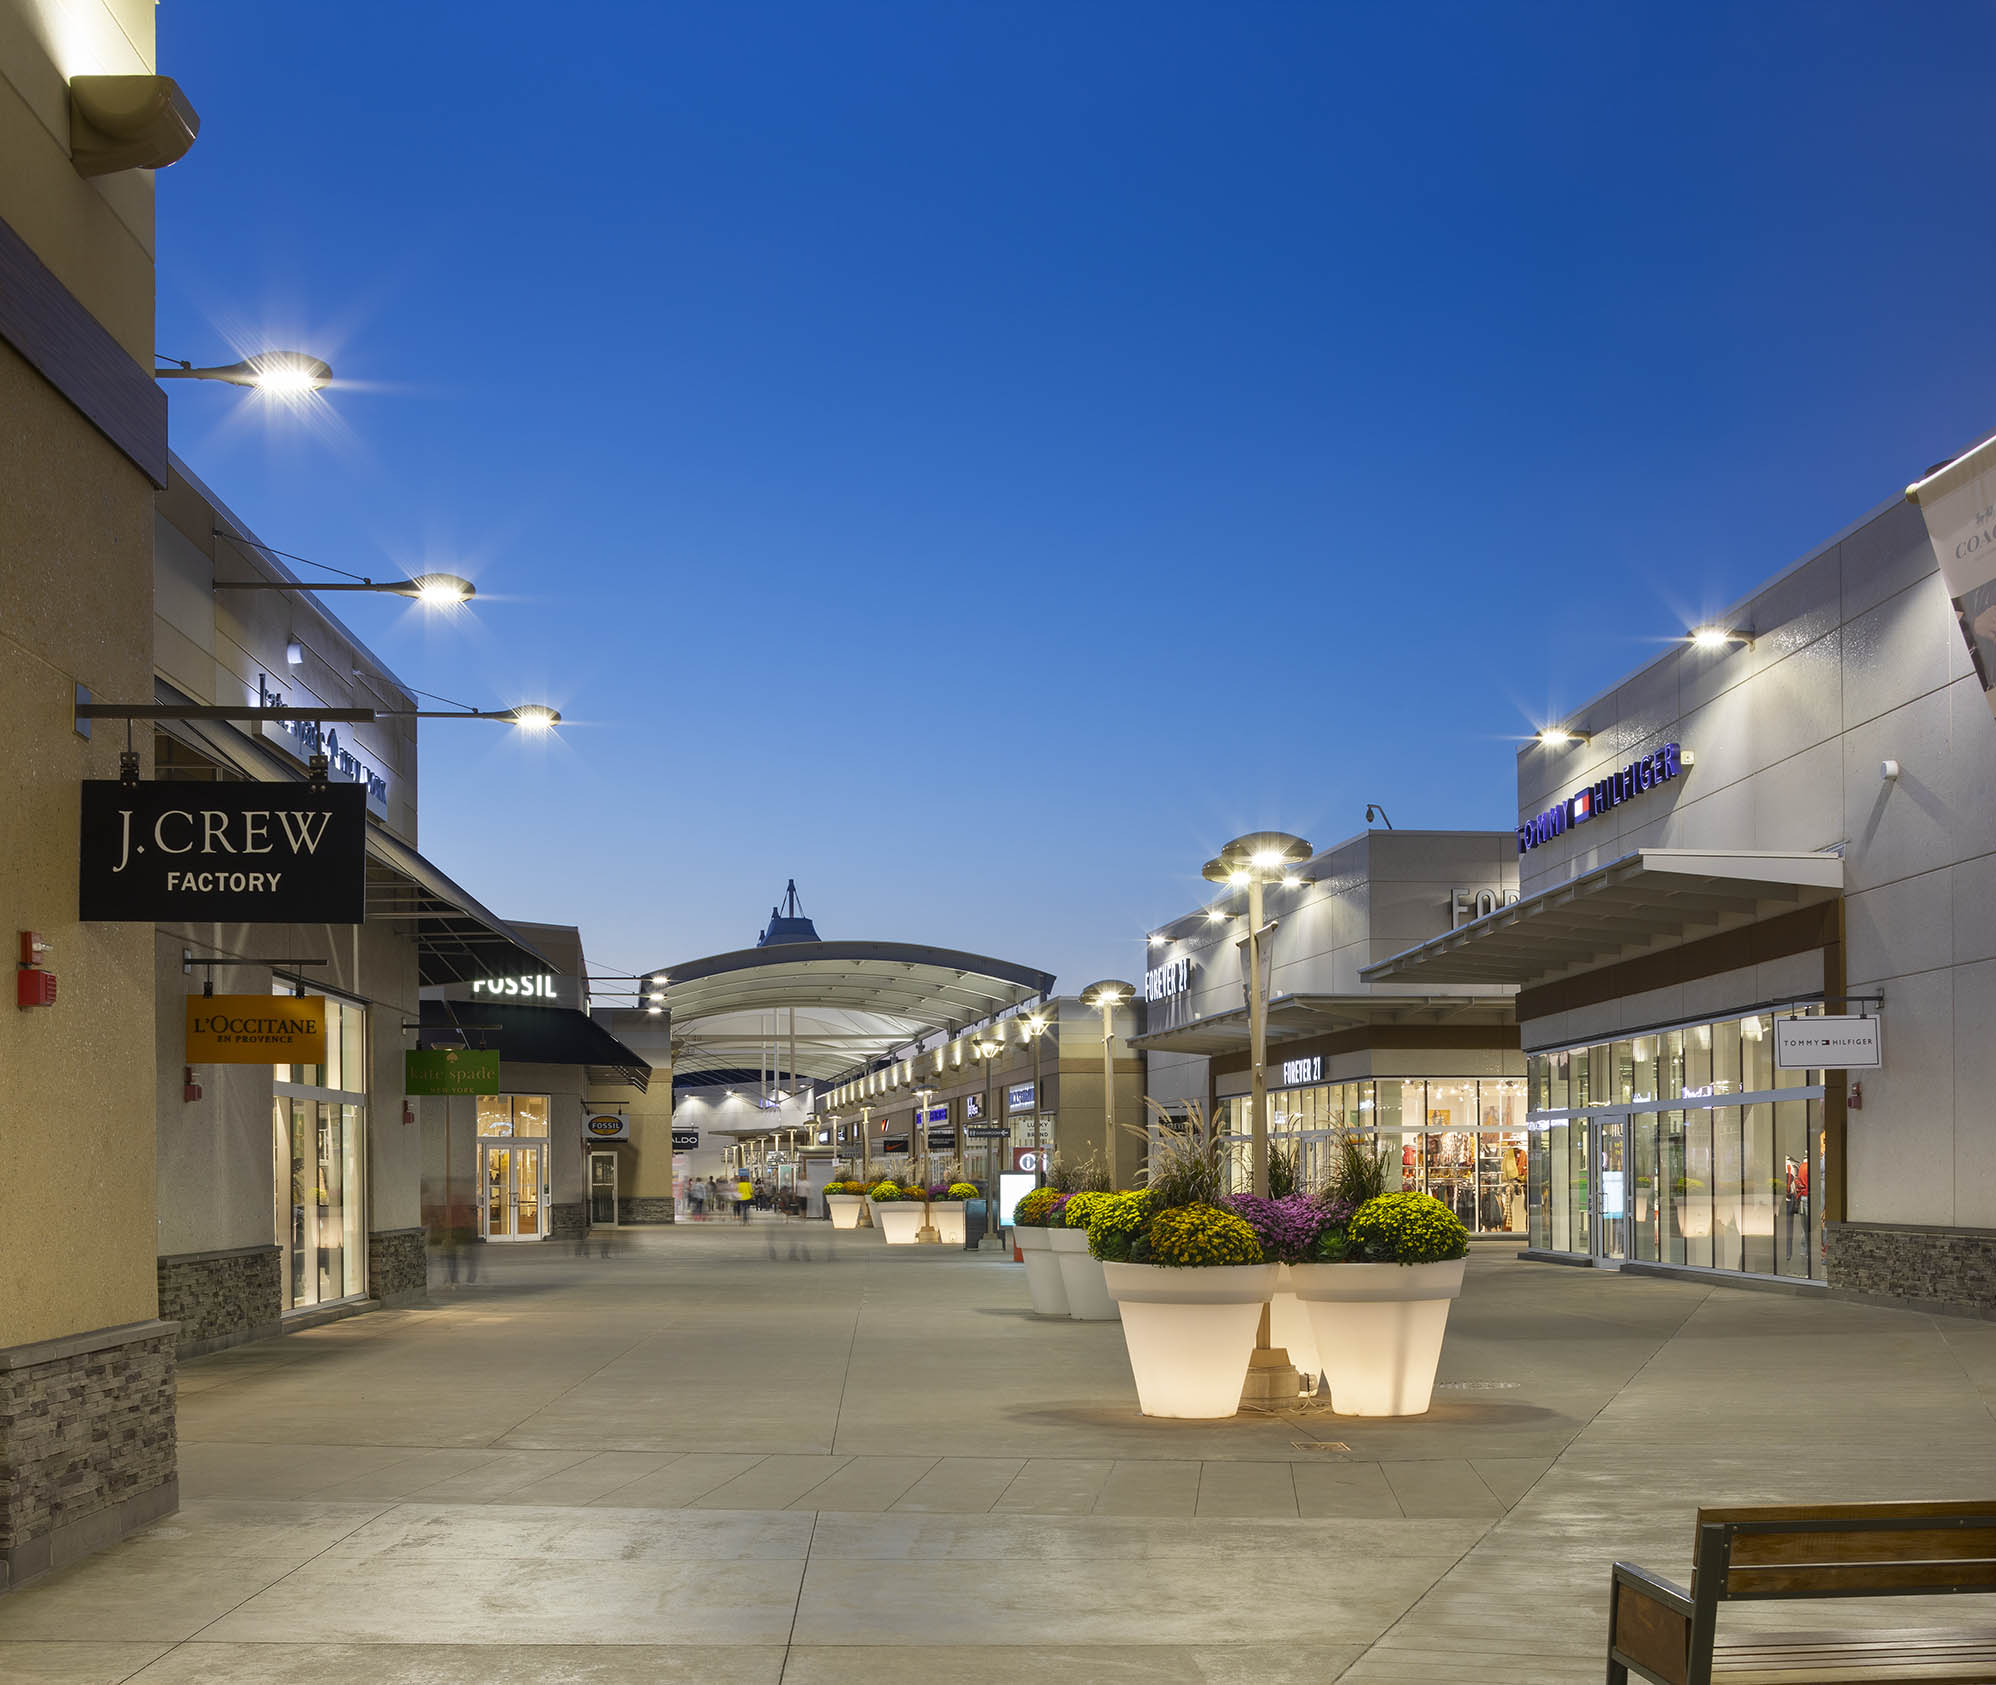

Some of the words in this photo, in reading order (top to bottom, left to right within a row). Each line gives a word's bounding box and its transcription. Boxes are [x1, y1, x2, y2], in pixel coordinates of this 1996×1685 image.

[1515, 800, 1571, 853] TOMMY
[1594, 742, 1682, 816] HILFIGER
[167, 872, 281, 892] FACTORY
[1145, 963, 1177, 1003] FOREVER
[1179, 959, 1188, 992] 21
[217, 1035, 232, 1043] EN
[236, 1035, 293, 1043] PROVENCE
[1832, 1038, 1873, 1046] HILFIGER
[449, 1066, 495, 1083] spade
[1283, 1059, 1311, 1084] FOREVER
[1313, 1056, 1320, 1080] 21
